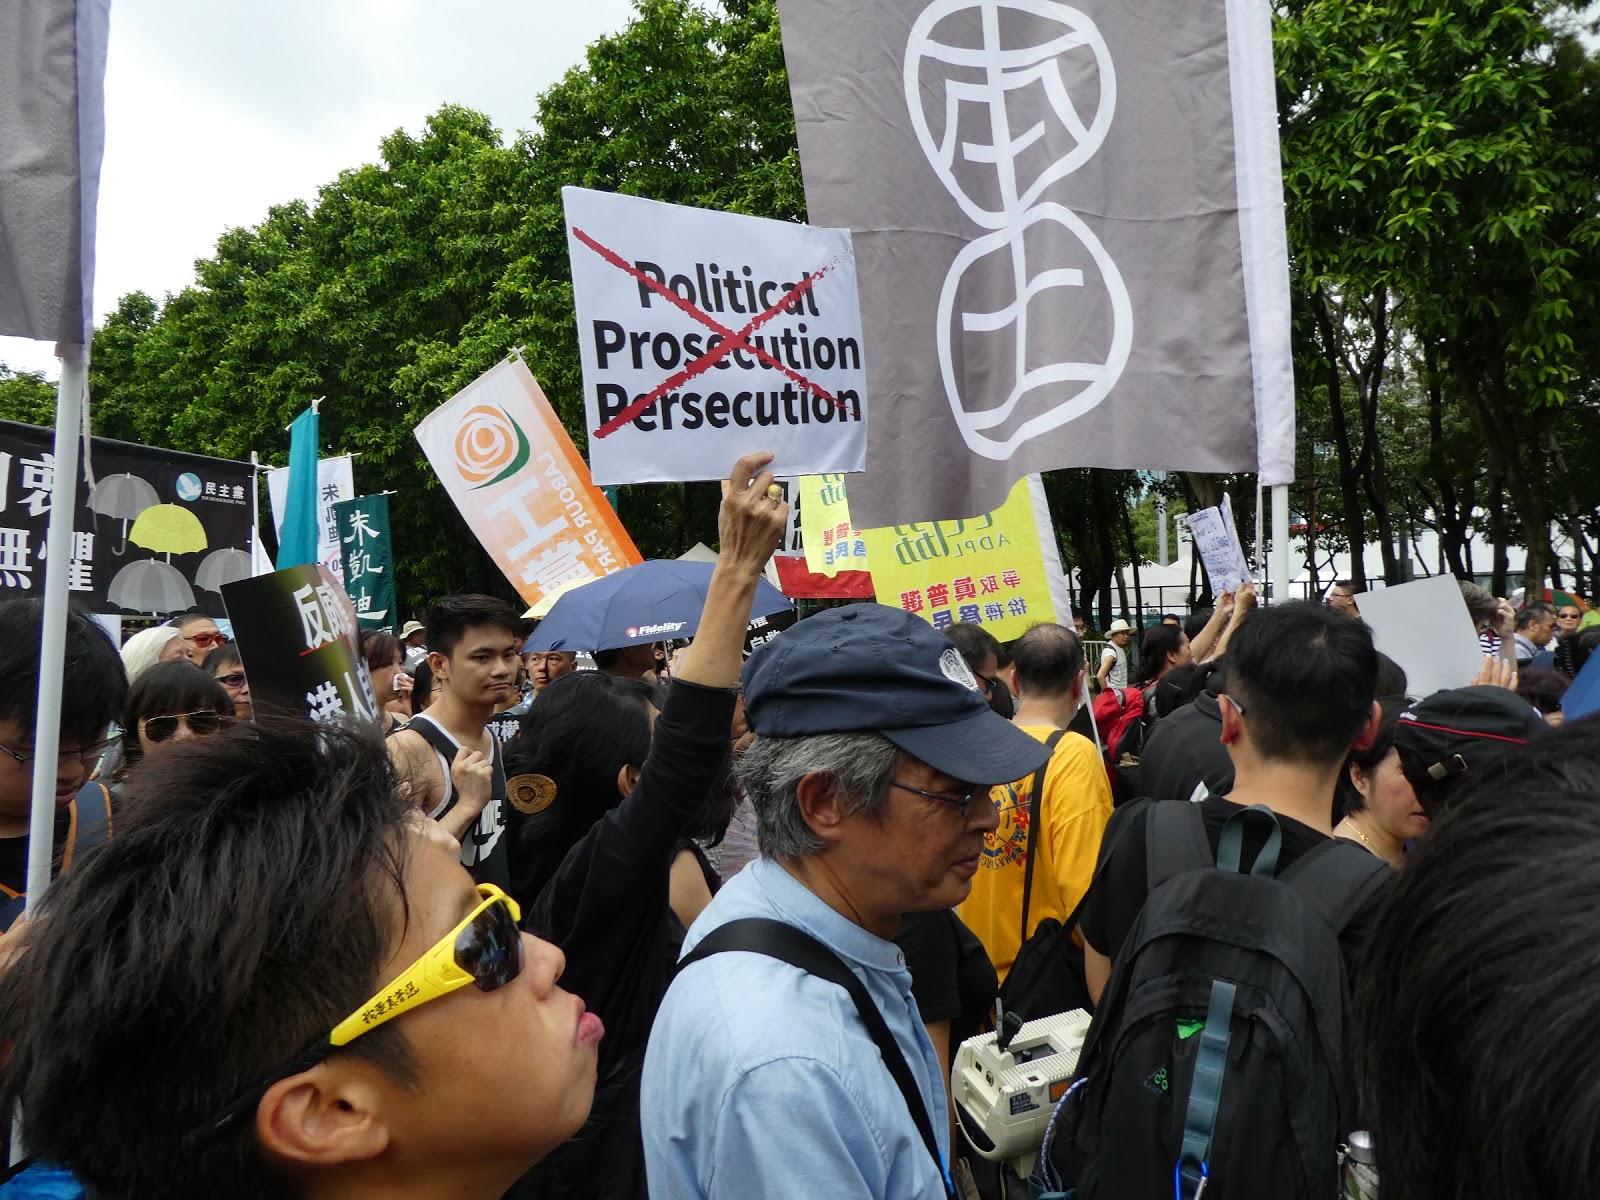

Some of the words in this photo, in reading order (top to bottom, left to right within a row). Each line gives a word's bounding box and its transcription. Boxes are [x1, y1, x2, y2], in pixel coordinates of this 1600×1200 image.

[634, 260, 820, 317] Political
[593, 319, 861, 371] Prosecution
[595, 382, 862, 432] Persecution
[205, 481, 245, 500] 民主黨
[638, 622, 682, 636] Fidelity
